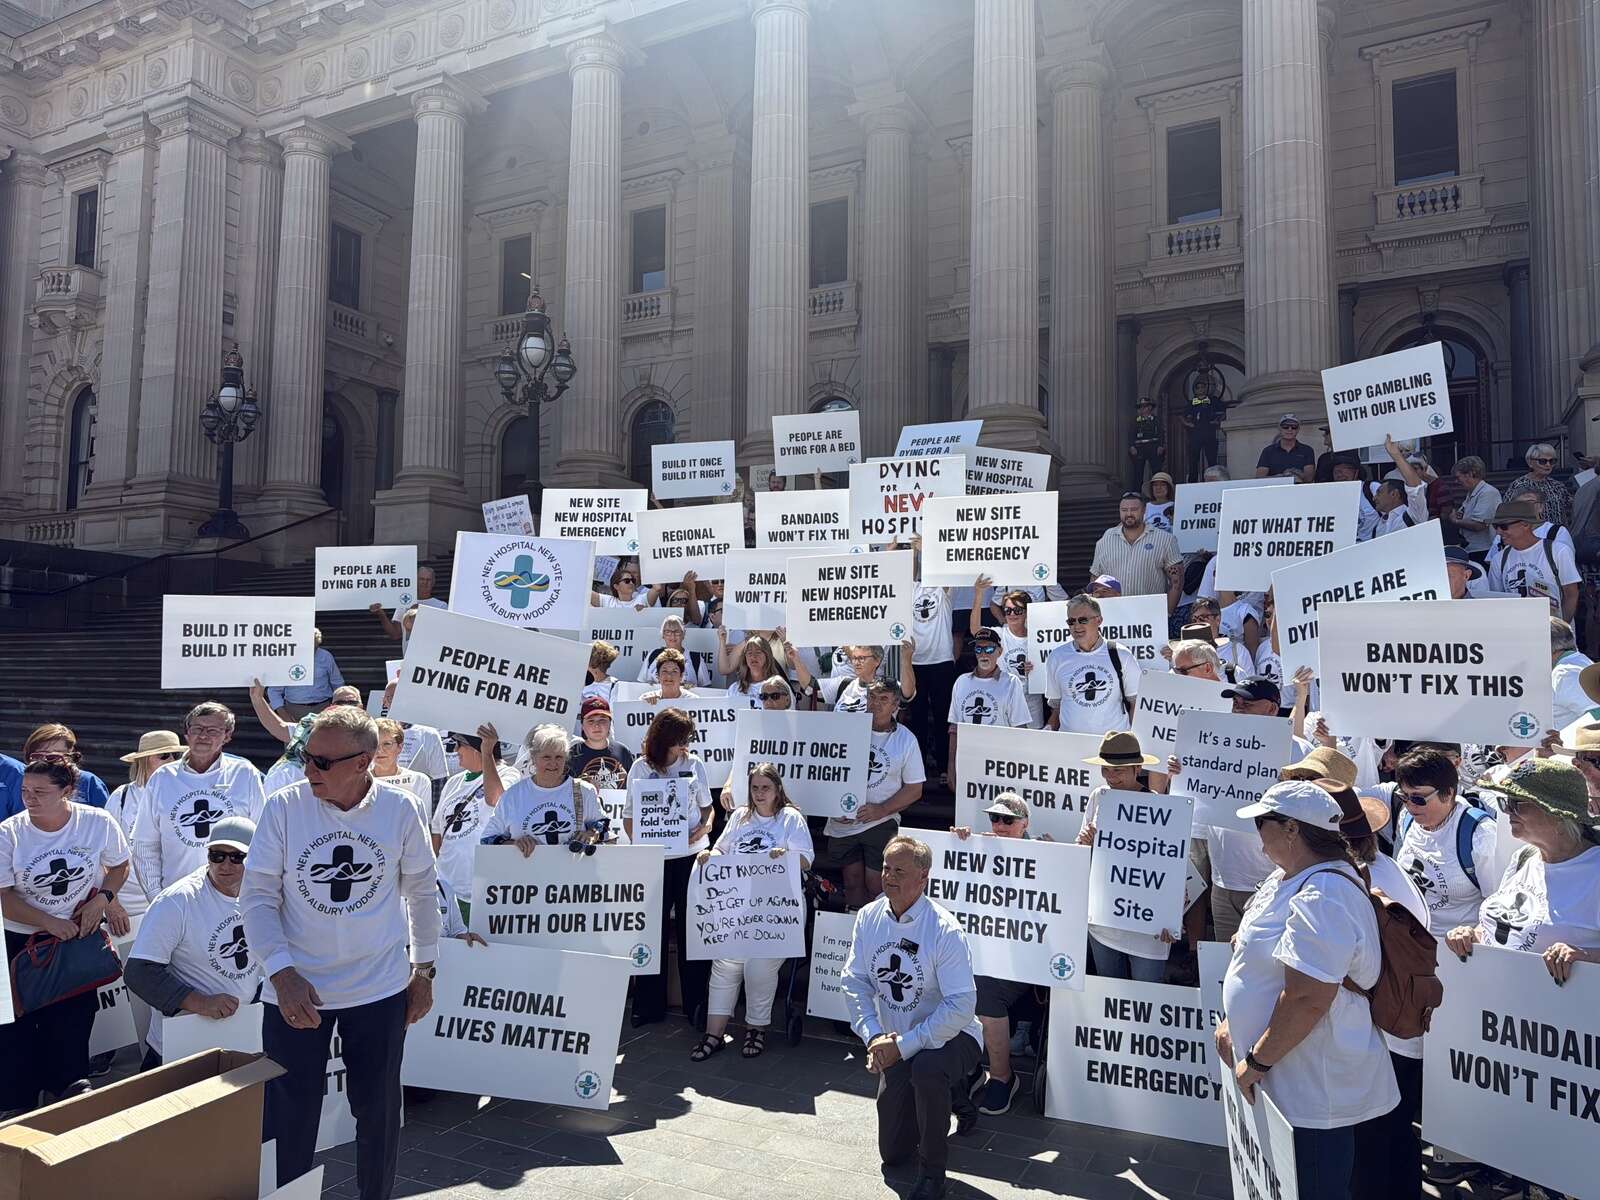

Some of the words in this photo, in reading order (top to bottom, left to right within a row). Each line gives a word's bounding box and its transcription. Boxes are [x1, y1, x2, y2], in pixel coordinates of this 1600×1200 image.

[1333, 388, 1362, 406] STOP
[1366, 372, 1433, 399] GAMBLING
[1337, 405, 1368, 423] WITH
[1371, 400, 1396, 416] OUR
[1399, 391, 1437, 411] LIVES
[789, 432, 823, 442] PEOPLE
[825, 430, 843, 440] ARE
[910, 437, 942, 446] PEOPLE
[943, 435, 961, 444] ARE
[780, 445, 808, 456] DYING
[809, 444, 827, 454] FOR
[838, 442, 856, 452] BED
[899, 447, 924, 457] DYING
[925, 446, 943, 456] FOR
[941, 446, 950, 455] A
[661, 459, 687, 469] BUILD
[689, 458, 698, 468] IT
[700, 457, 723, 467] ONCE
[879, 459, 940, 480] DYING
[975, 455, 999, 468] NEW
[1000, 458, 1024, 472] SITE
[661, 472, 687, 481] BUILD
[689, 471, 698, 480] IT
[700, 469, 726, 479] RIGHT
[985, 472, 1034, 489] HOSPITAL
[880, 484, 898, 493] FOR
[914, 482, 921, 490] A
[569, 498, 593, 508] NEW
[597, 498, 620, 508] SITE
[554, 512, 579, 523] NEW
[582, 512, 634, 523] HOSPITAL
[781, 512, 839, 525] BANDAIDS
[956, 507, 986, 522] NEW
[990, 506, 1021, 520] SITE
[560, 526, 626, 537] EMERGENCY
[1181, 517, 1216, 530] DYING
[1232, 519, 1258, 535] NOT
[1262, 517, 1302, 534] WHAT
[1307, 516, 1335, 532] THE
[662, 528, 716, 543] REGIONAL
[768, 529, 804, 542] WON'T
[808, 529, 827, 541] FIX
[939, 528, 970, 542] NEW
[972, 526, 1039, 541] HOSPITAL
[652, 545, 688, 559] LIVES
[946, 546, 1030, 562] EMERGENCY
[1233, 541, 1262, 557] DR'S
[1267, 541, 1334, 557] ORDERED
[333, 565, 372, 576] PEOPLE
[376, 564, 396, 575] ARE
[482, 556, 496, 578] NEW
[537, 546, 557, 563] NEW
[551, 562, 563, 582] SITE
[818, 566, 846, 581] NEW
[850, 564, 879, 579] SITE
[322, 579, 353, 590] DYING
[357, 578, 377, 589] FOR
[380, 578, 387, 588] A
[391, 578, 411, 588] BED
[1371, 568, 1407, 595] ARE
[735, 590, 772, 604] WON'T
[802, 587, 830, 602] NEW
[833, 584, 896, 600] HOSPITAL
[489, 602, 523, 621] ALBURY
[522, 588, 561, 621] WODONGA
[809, 605, 888, 621] EMERGENCY
[182, 624, 228, 637] BUILD
[234, 624, 248, 637] IT
[253, 623, 292, 637] ONCE
[591, 629, 622, 641] BUILD
[624, 629, 634, 641] IT
[1036, 629, 1071, 643] STOP
[182, 644, 227, 657] BUILD
[233, 643, 247, 657] IT
[253, 643, 296, 657] RIGHT
[623, 645, 633, 656] IT
[1367, 643, 1484, 664] BANDAIDS
[439, 645, 510, 676] PEOPLE
[513, 663, 550, 686] ARE
[411, 666, 471, 694] DYING
[474, 680, 512, 703] FOR
[515, 689, 528, 706] A
[533, 692, 569, 715] BED
[1342, 672, 1412, 694] WON'T
[1421, 674, 1459, 695] FIX
[1467, 675, 1524, 697] THIS
[1139, 697, 1182, 717] NEW
[626, 712, 655, 727] OUR
[750, 739, 788, 756] BUILD
[792, 741, 807, 756] IT
[810, 742, 848, 759] ONCE
[1199, 730, 1219, 745] It's
[1223, 737, 1231, 747] a
[1236, 735, 1266, 751] sub-
[789, 763, 805, 779] IT
[807, 764, 851, 783] RIGHT
[984, 759, 1049, 783] PEOPLE
[1054, 766, 1090, 787] ARE
[1182, 756, 1243, 774] standard
[641, 793, 659, 802] not
[1022, 788, 1056, 809] FOR
[1061, 793, 1074, 811] A
[641, 805, 670, 816] going
[1117, 803, 1172, 826] NEW
[640, 817, 659, 826] fold
[641, 829, 681, 838] minister
[296, 848, 311, 871] NEW
[357, 834, 378, 850] NEW
[1097, 830, 1186, 859] Hospital
[943, 850, 987, 874] NEW
[992, 855, 1037, 880] SITE
[699, 865, 703, 884] I
[705, 864, 731, 882] GET
[736, 864, 786, 878] KNOCKED
[1110, 865, 1166, 889] NEW
[297, 880, 311, 899] FOR
[307, 897, 343, 916] ALBURY
[486, 884, 539, 906] STOP
[545, 883, 645, 905] GAMBLING
[965, 883, 1062, 915] HOSPITAL
[717, 901, 726, 911] I
[726, 897, 744, 908] GET
[749, 897, 763, 907] UP
[766, 896, 799, 907] AGAIN
[1113, 898, 1154, 921] Site
[488, 914, 541, 935] WITH
[547, 913, 586, 934] OUR
[593, 911, 646, 932] LIVES
[697, 919, 736, 938] YOU'RE
[738, 915, 764, 926] NEVER
[766, 914, 799, 925] GONNA
[703, 932, 729, 945] KEEP
[734, 930, 750, 940] ME
[753, 928, 785, 941] DOWN
[823, 935, 836, 945] I'm
[815, 952, 846, 962] medical
[815, 966, 828, 975] the
[821, 982, 840, 993] have
[463, 985, 567, 1018] REGIONAL
[1104, 997, 1152, 1024] NEW
[1160, 1004, 1204, 1031] SITE
[434, 1015, 496, 1043] LIVES
[501, 1023, 591, 1055] MATTER
[1075, 1026, 1123, 1052] NEW
[1087, 1060, 1222, 1101] EMERGENCY
[1450, 1048, 1538, 1104] WON'T
[1550, 1077, 1600, 1124] FIX
